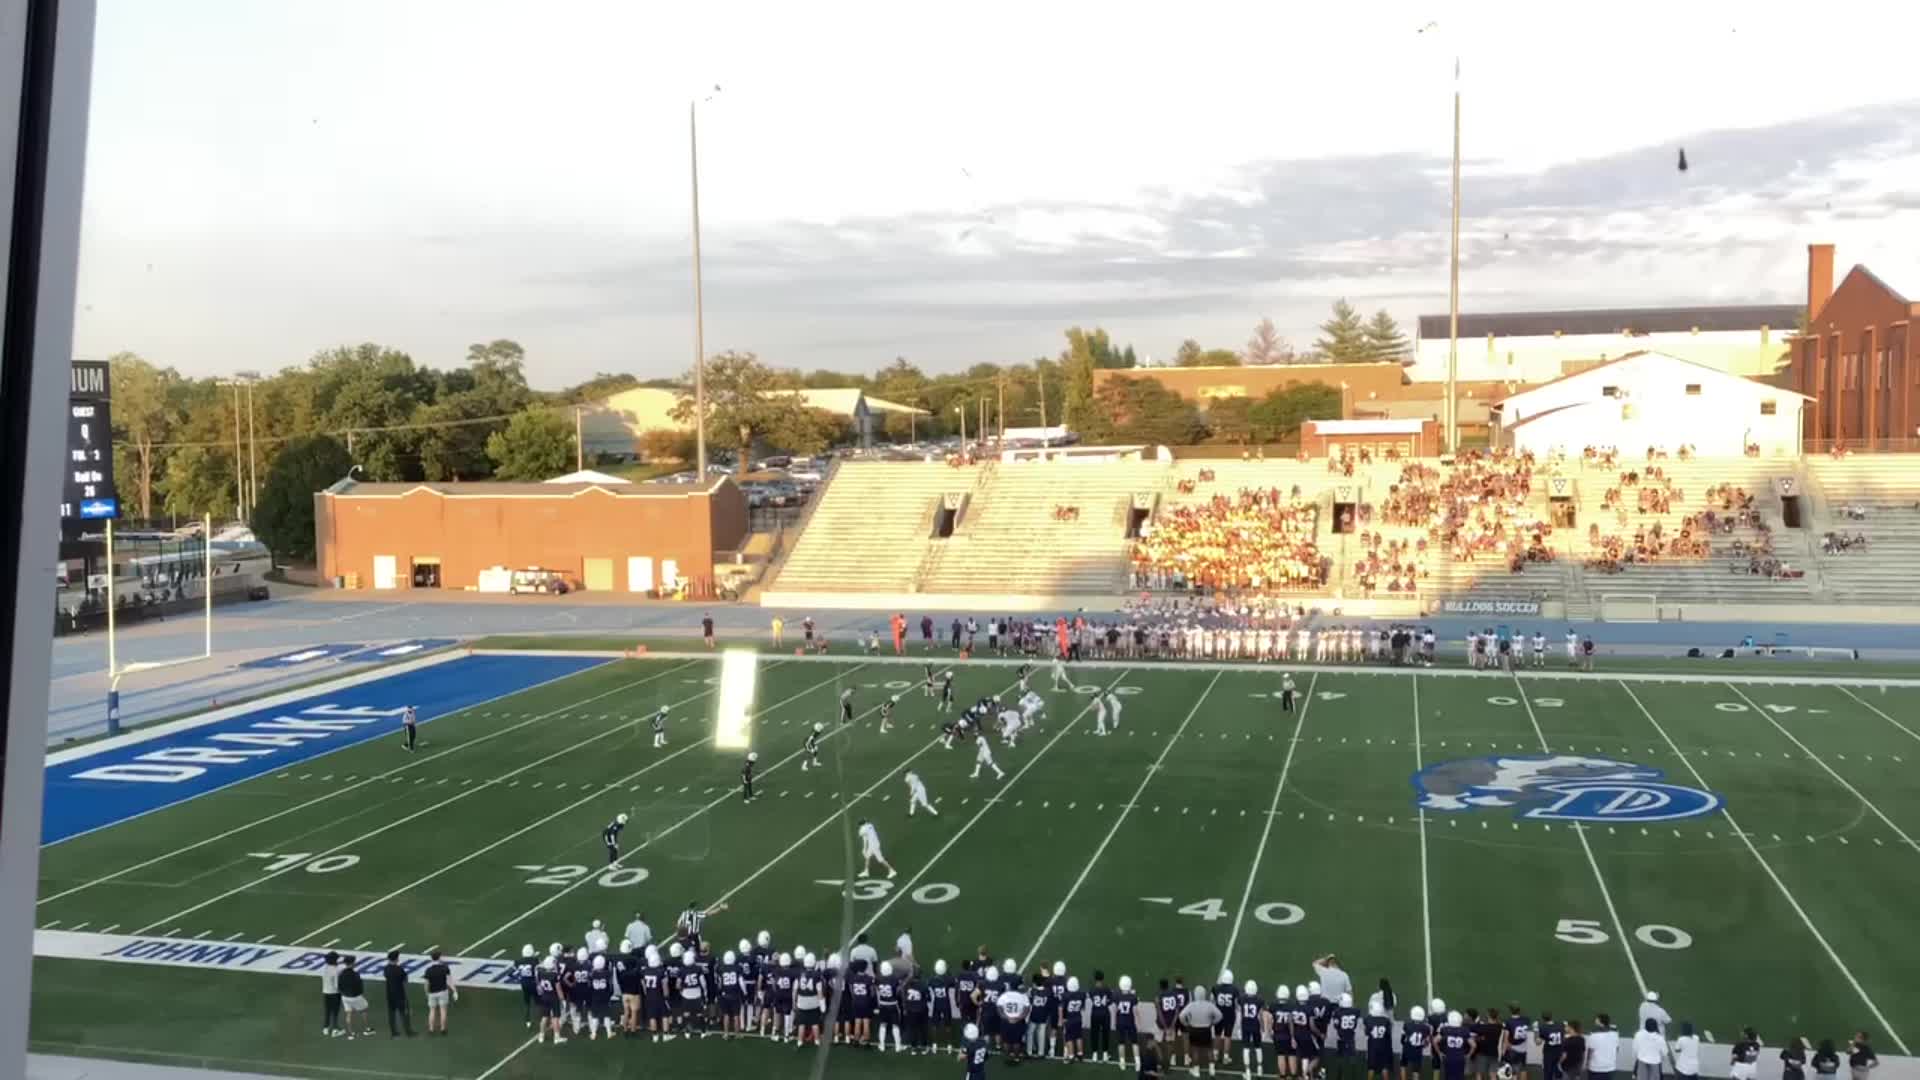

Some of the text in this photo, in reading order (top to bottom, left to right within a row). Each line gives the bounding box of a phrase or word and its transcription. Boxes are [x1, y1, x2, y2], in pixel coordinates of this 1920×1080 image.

[1444, 600, 1539, 613] BULLDOG SOCCER
[70, 703, 419, 783] DRAKE
[101, 940, 284, 966] JOHNNY
[684, 973, 699, 986] 45
[1217, 993, 1233, 1007] 65
[1244, 1004, 1257, 1018] 13
